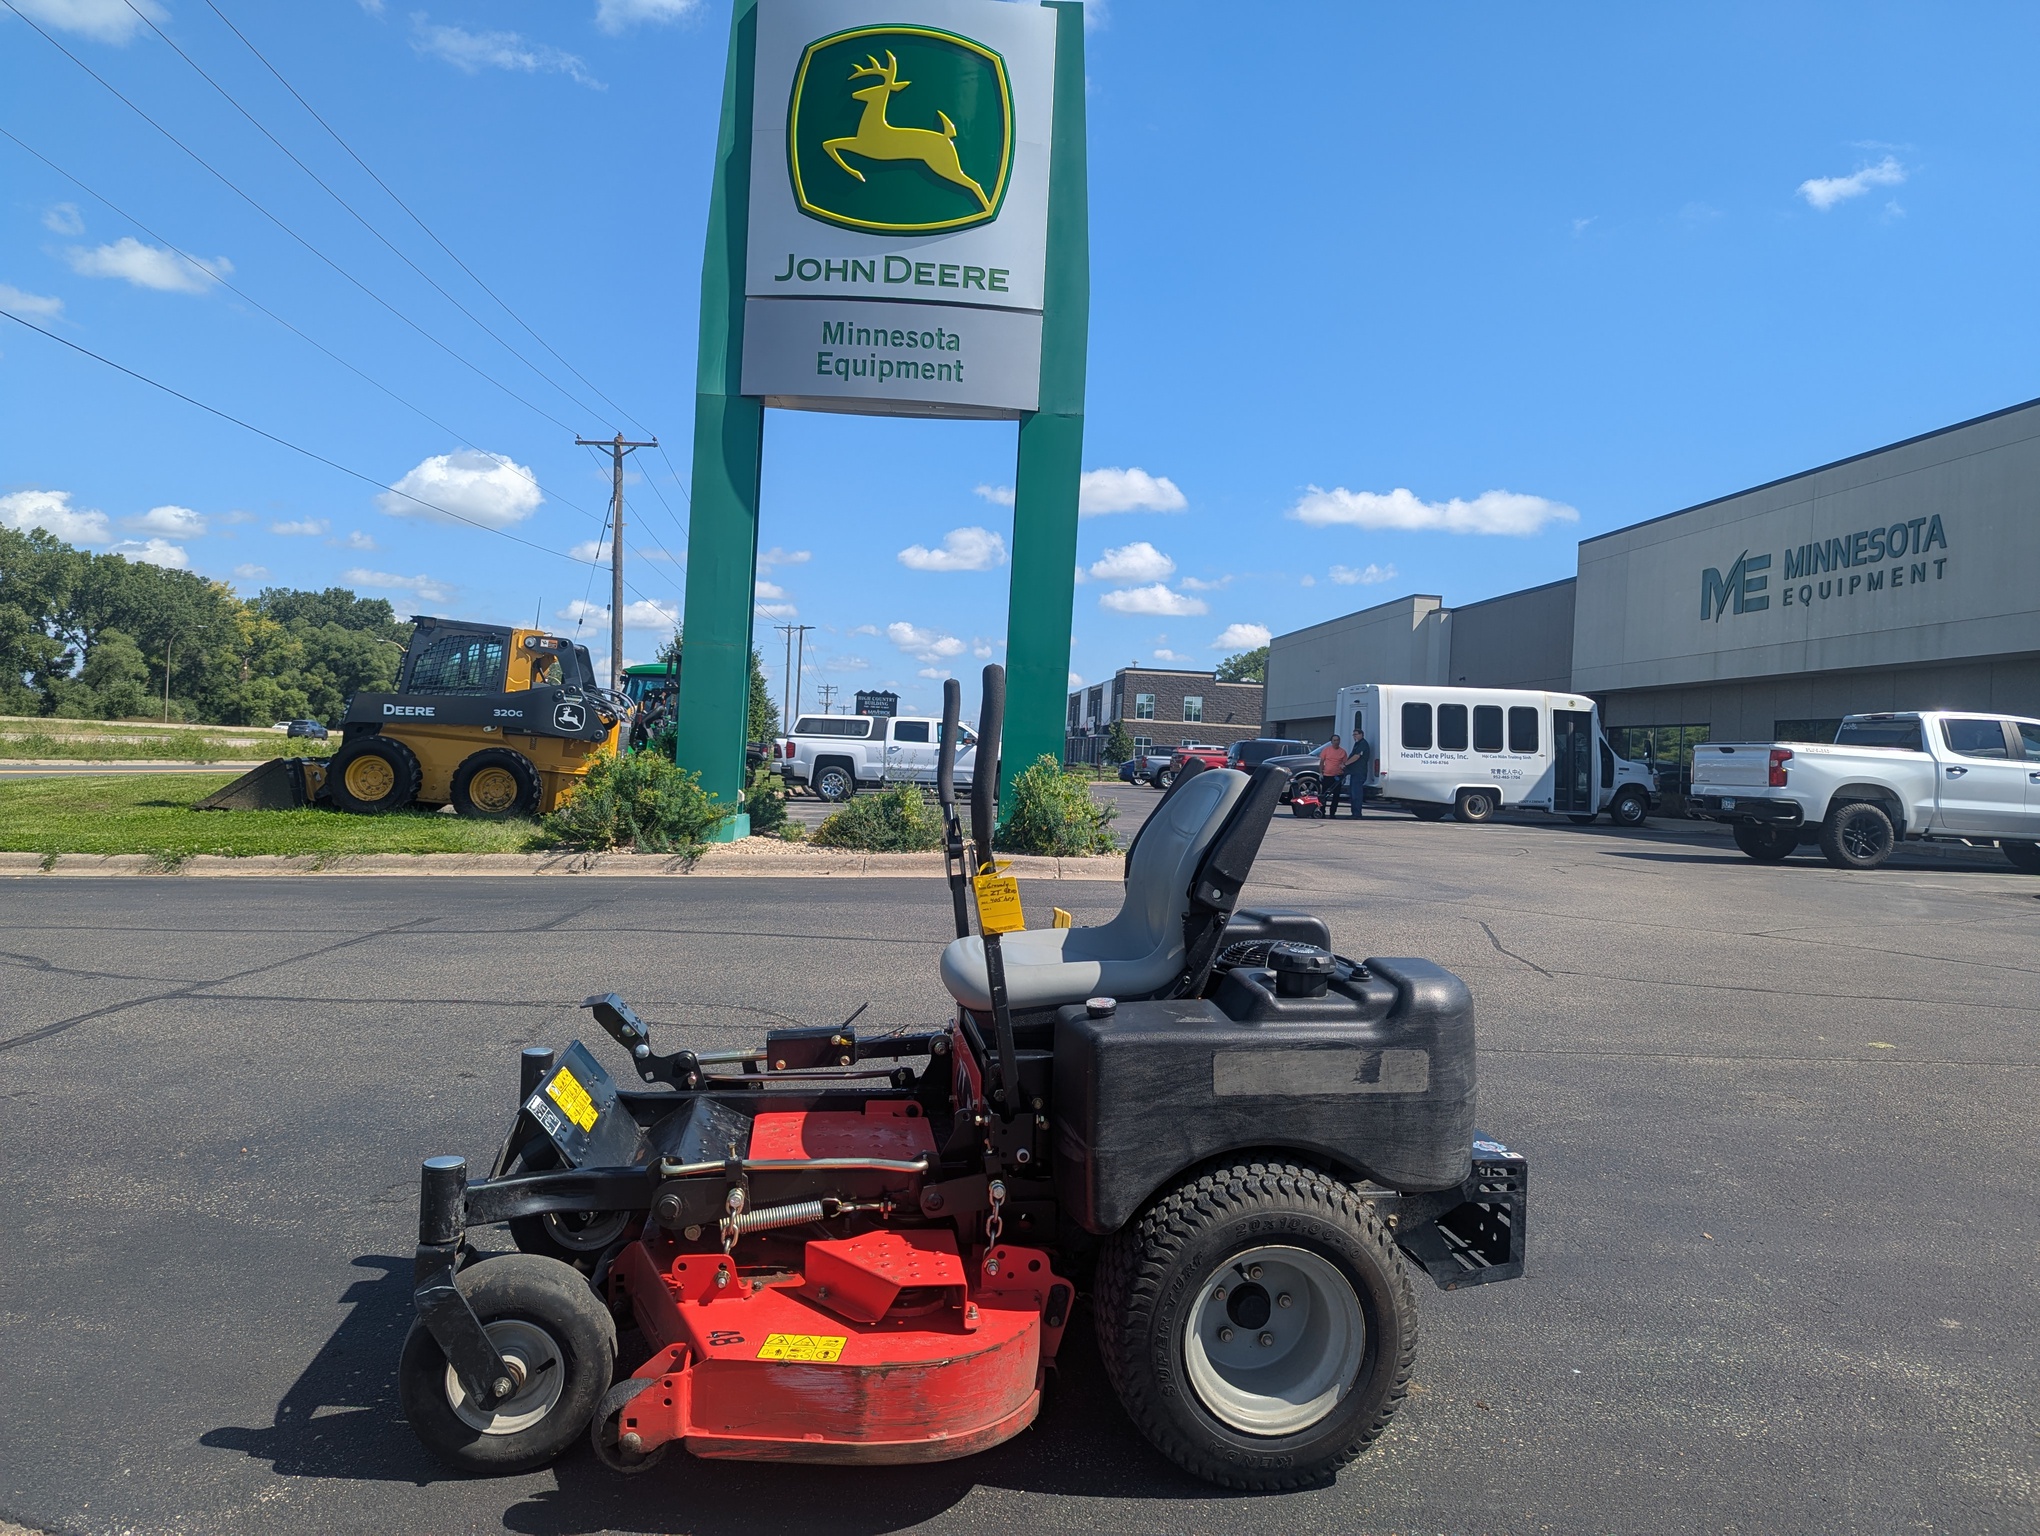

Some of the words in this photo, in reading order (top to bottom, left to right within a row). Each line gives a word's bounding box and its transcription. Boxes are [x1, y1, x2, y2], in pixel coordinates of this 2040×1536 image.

[774, 253, 875, 283] JOHN
[884, 255, 1010, 293] DEERE
[822, 321, 960, 352] Minnesota
[816, 352, 963, 384] Equipment
[1783, 514, 1948, 581] MINNESOTA
[1782, 558, 1948, 607] EQUIPMENT
[383, 703, 435, 716] DEERE
[493, 709, 523, 717] 320G
[1165, 1250, 1203, 1310] TURF
[1155, 1316, 1176, 1398] SUPER
[1211, 1440, 1294, 1468] KENDA
